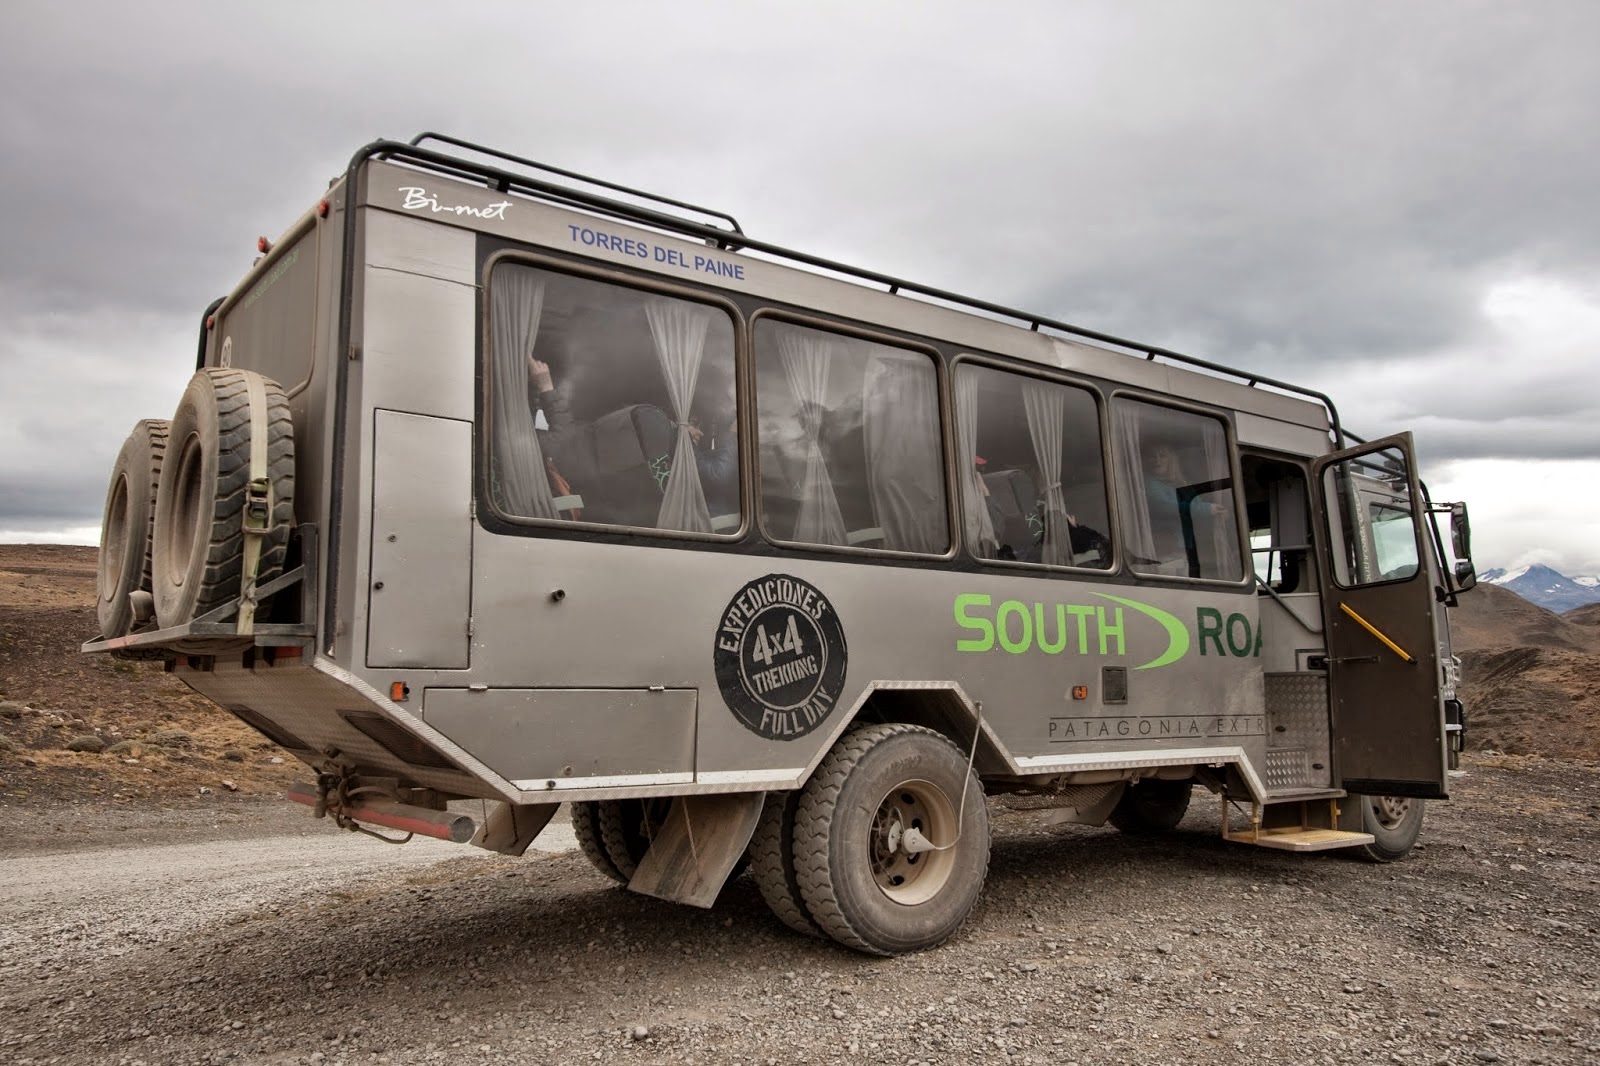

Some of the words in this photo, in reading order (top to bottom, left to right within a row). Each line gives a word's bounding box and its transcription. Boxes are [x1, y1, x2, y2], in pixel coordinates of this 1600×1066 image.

[398, 186, 513, 221] Bi-met
[568, 224, 649, 259] TORRES
[654, 246, 690, 270] DEL
[694, 256, 746, 281] PAINE
[719, 578, 827, 653] EXPEDICIONES
[753, 614, 804, 666] 4x4
[953, 593, 1126, 655] SOUTH
[752, 654, 818, 695] TREKKING
[759, 708, 804, 735] FULL
[802, 684, 834, 727] DAY
[1049, 719, 1199, 738] PATAGONIA
[1216, 718, 1264, 733] EXTR
